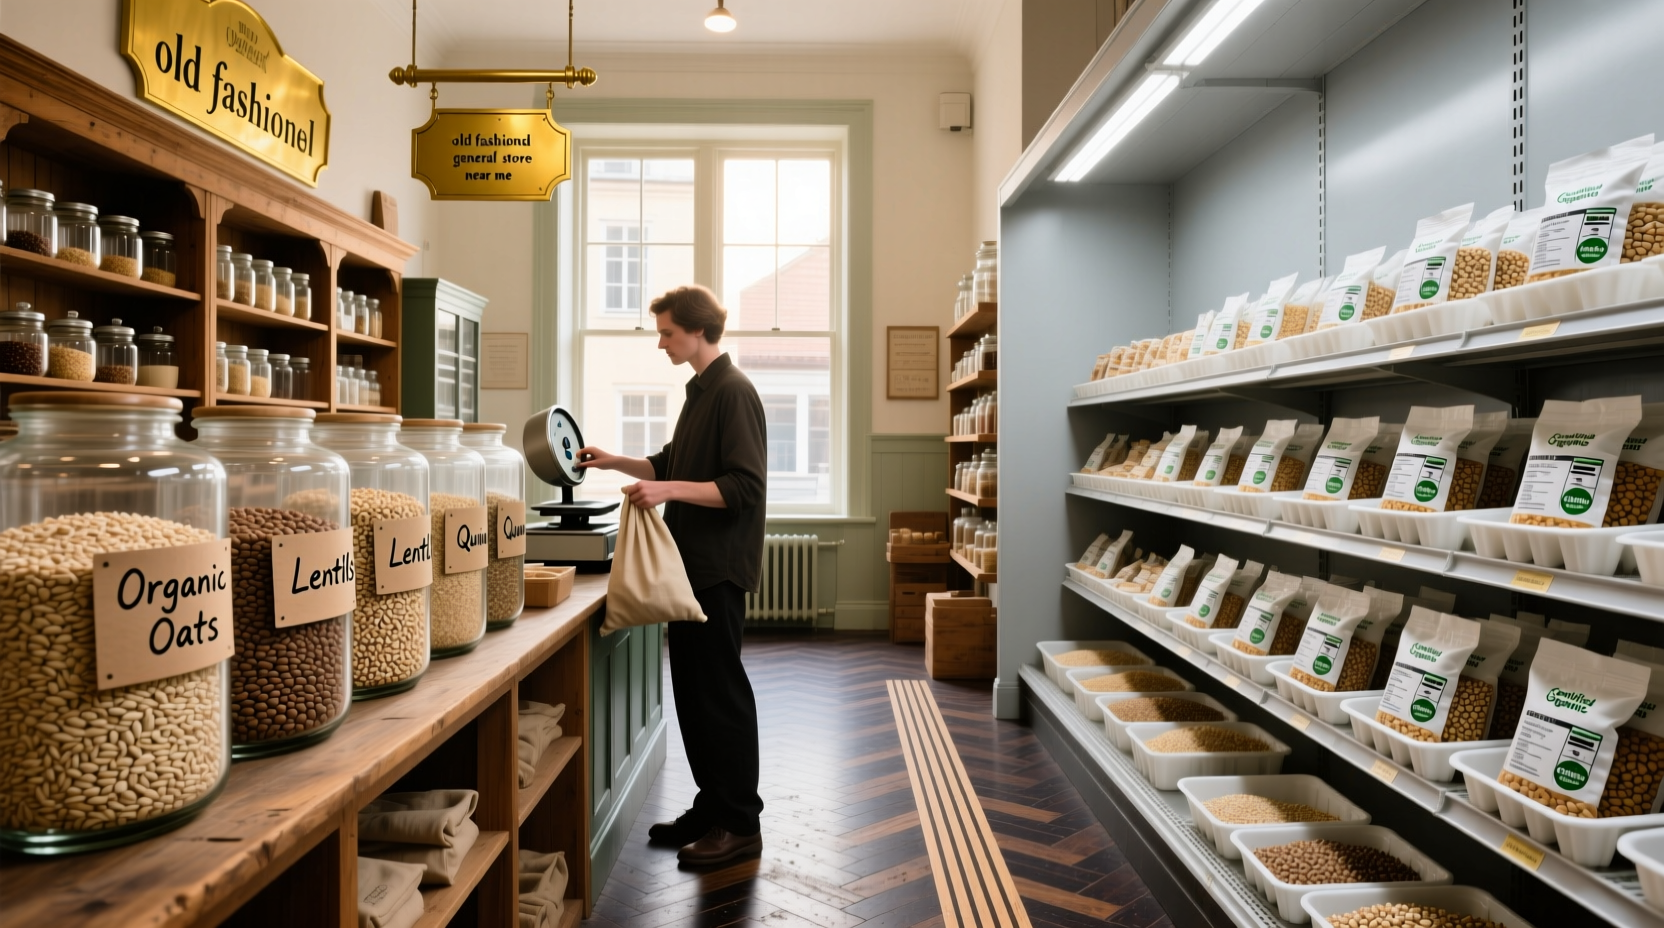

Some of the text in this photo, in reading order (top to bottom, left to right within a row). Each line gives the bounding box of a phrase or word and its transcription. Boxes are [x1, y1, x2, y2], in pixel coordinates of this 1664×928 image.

[155, 33, 202, 93] old
[452, 133, 472, 147] old
[453, 151, 533, 168] general store
[465, 172, 512, 181] near me
[117, 564, 227, 614] Organic
[149, 610, 218, 656] Oats
